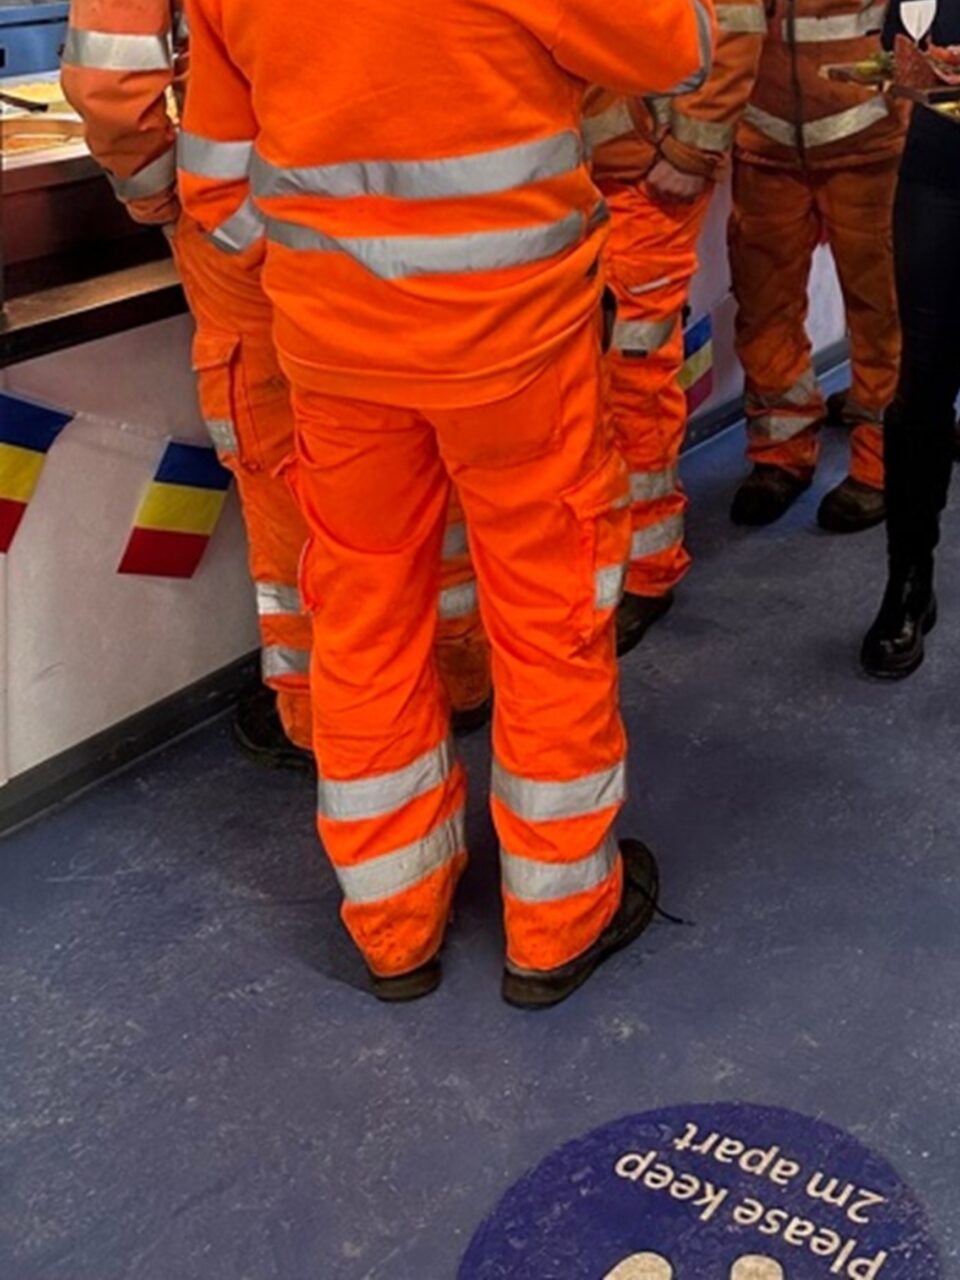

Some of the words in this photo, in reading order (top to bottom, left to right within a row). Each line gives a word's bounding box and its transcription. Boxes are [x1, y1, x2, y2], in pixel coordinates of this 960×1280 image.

[615, 1150, 728, 1221] keep
[673, 1122, 800, 1185] apart
[805, 1171, 888, 1224] 2m
[733, 1196, 888, 1280] Please
